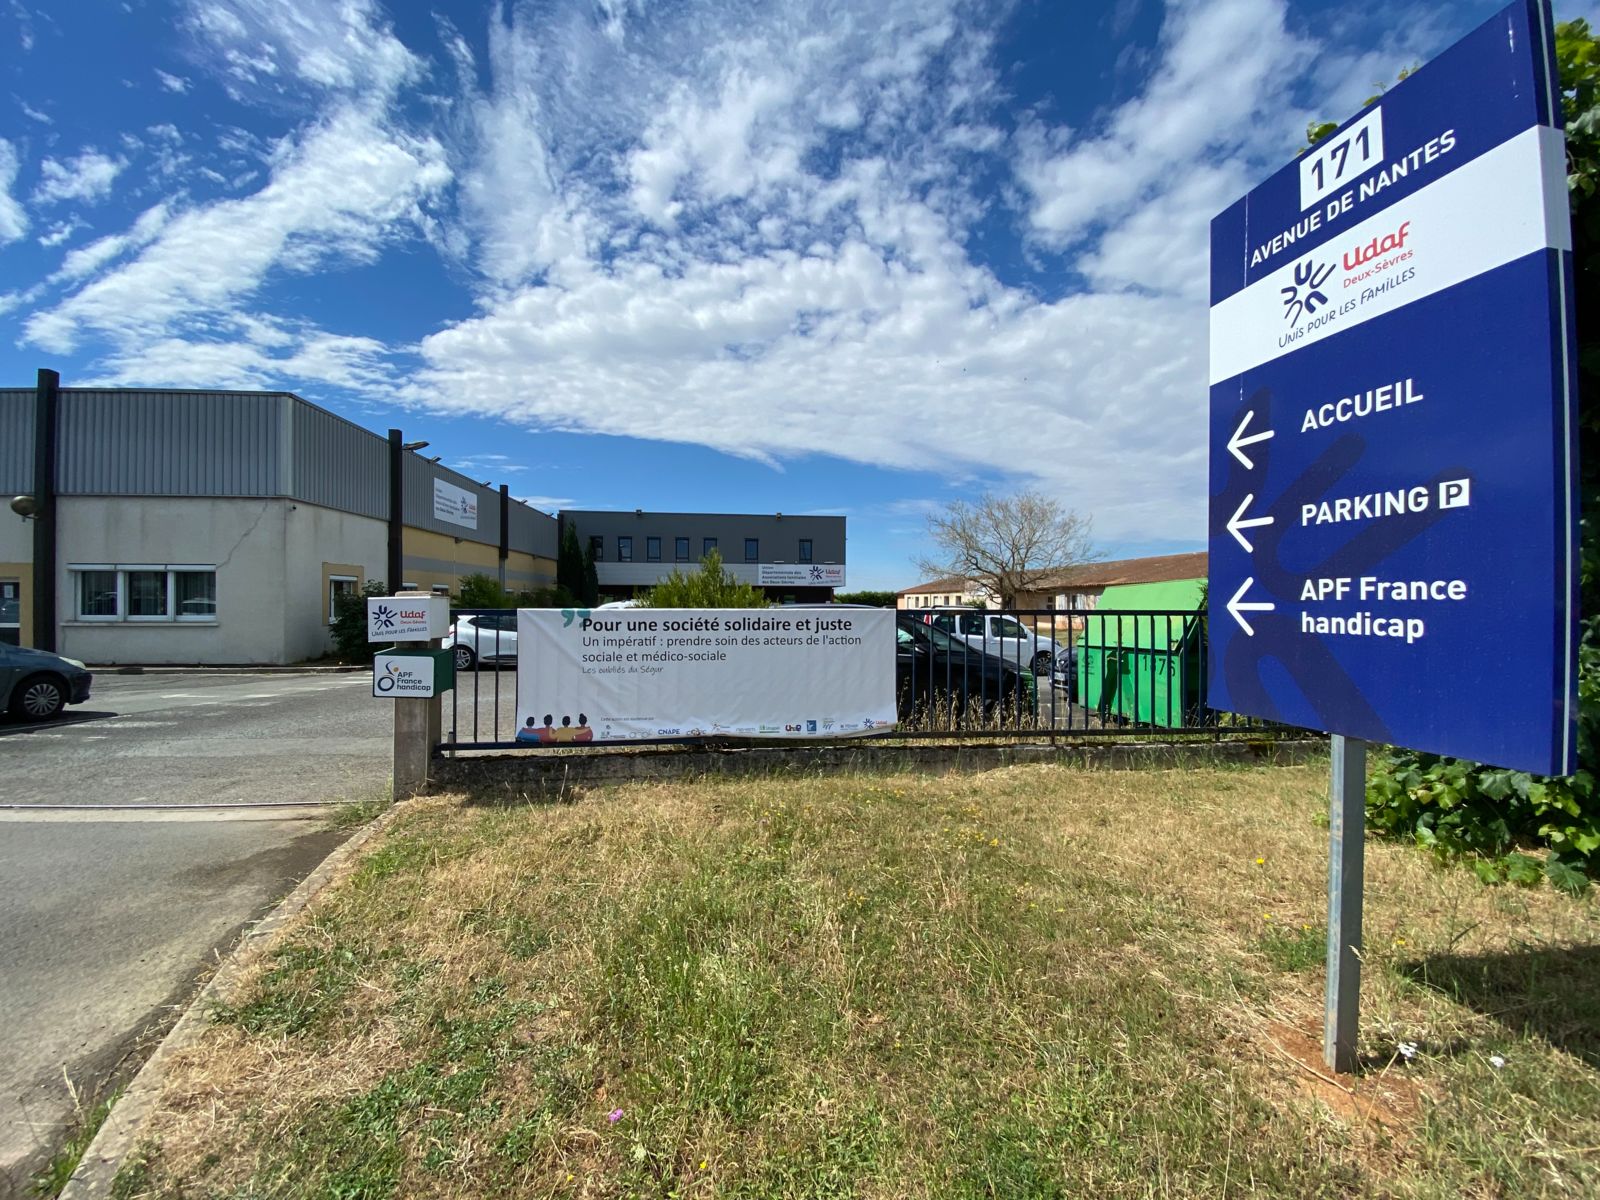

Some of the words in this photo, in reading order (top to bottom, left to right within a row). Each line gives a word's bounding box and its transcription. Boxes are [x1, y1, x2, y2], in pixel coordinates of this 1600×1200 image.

[1310, 125, 1371, 192] 171
[1250, 209, 1322, 268] AVENUE
[1327, 190, 1354, 222] DE
[1360, 129, 1456, 202] NANTES
[1343, 221, 1411, 271] Udaf
[1343, 249, 1413, 288] Deux-Sèvres
[1300, 378, 1424, 433] ACCUEIL
[1302, 486, 1429, 527] PARKING
[1300, 577, 1352, 601] APF
[1360, 576, 1467, 601] France
[400, 610, 426, 619] Udaf
[583, 618, 622, 632] Pour
[627, 620, 658, 632] une
[662, 617, 720, 632] société
[724, 617, 791, 631] solidaire
[796, 619, 811, 631] et
[815, 618, 852, 634] juste
[1301, 611, 1425, 644] handicap
[583, 637, 599, 647] Un
[603, 636, 657, 648] impératif
[667, 636, 712, 648] prendre
[715, 635, 738, 646] soin
[741, 635, 760, 646] des
[763, 636, 803, 646] acteurs
[806, 635, 820, 645] de
[822, 635, 862, 645] l'action
[582, 651, 623, 662] sociale
[626, 653, 638, 662] et
[641, 651, 727, 662] médico-sociale
[628, 666, 638, 674] du
[640, 665, 664, 676] Ségur
[396, 684, 431, 692] handicap
